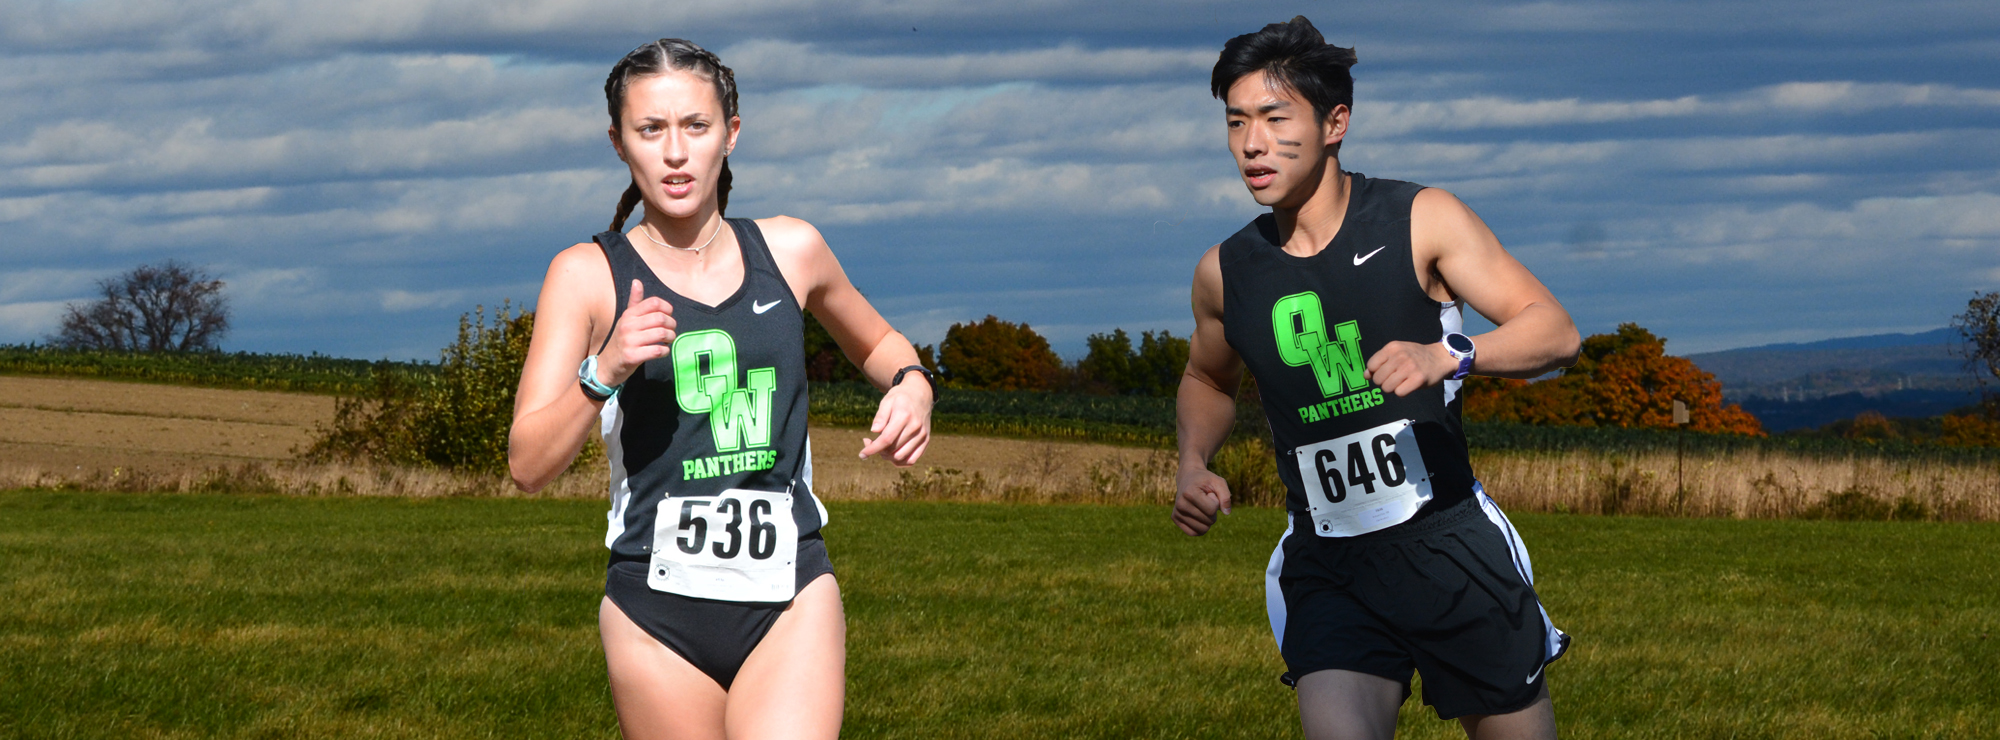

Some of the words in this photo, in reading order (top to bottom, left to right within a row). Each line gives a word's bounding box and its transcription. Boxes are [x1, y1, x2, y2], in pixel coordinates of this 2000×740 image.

[1272, 291, 1369, 398] OW
[672, 328, 776, 452] OW
[1298, 388, 1384, 424] PANTHERS
[682, 450, 777, 481] PANTHERS
[1315, 433, 1406, 503] 646
[676, 498, 777, 560] 536
